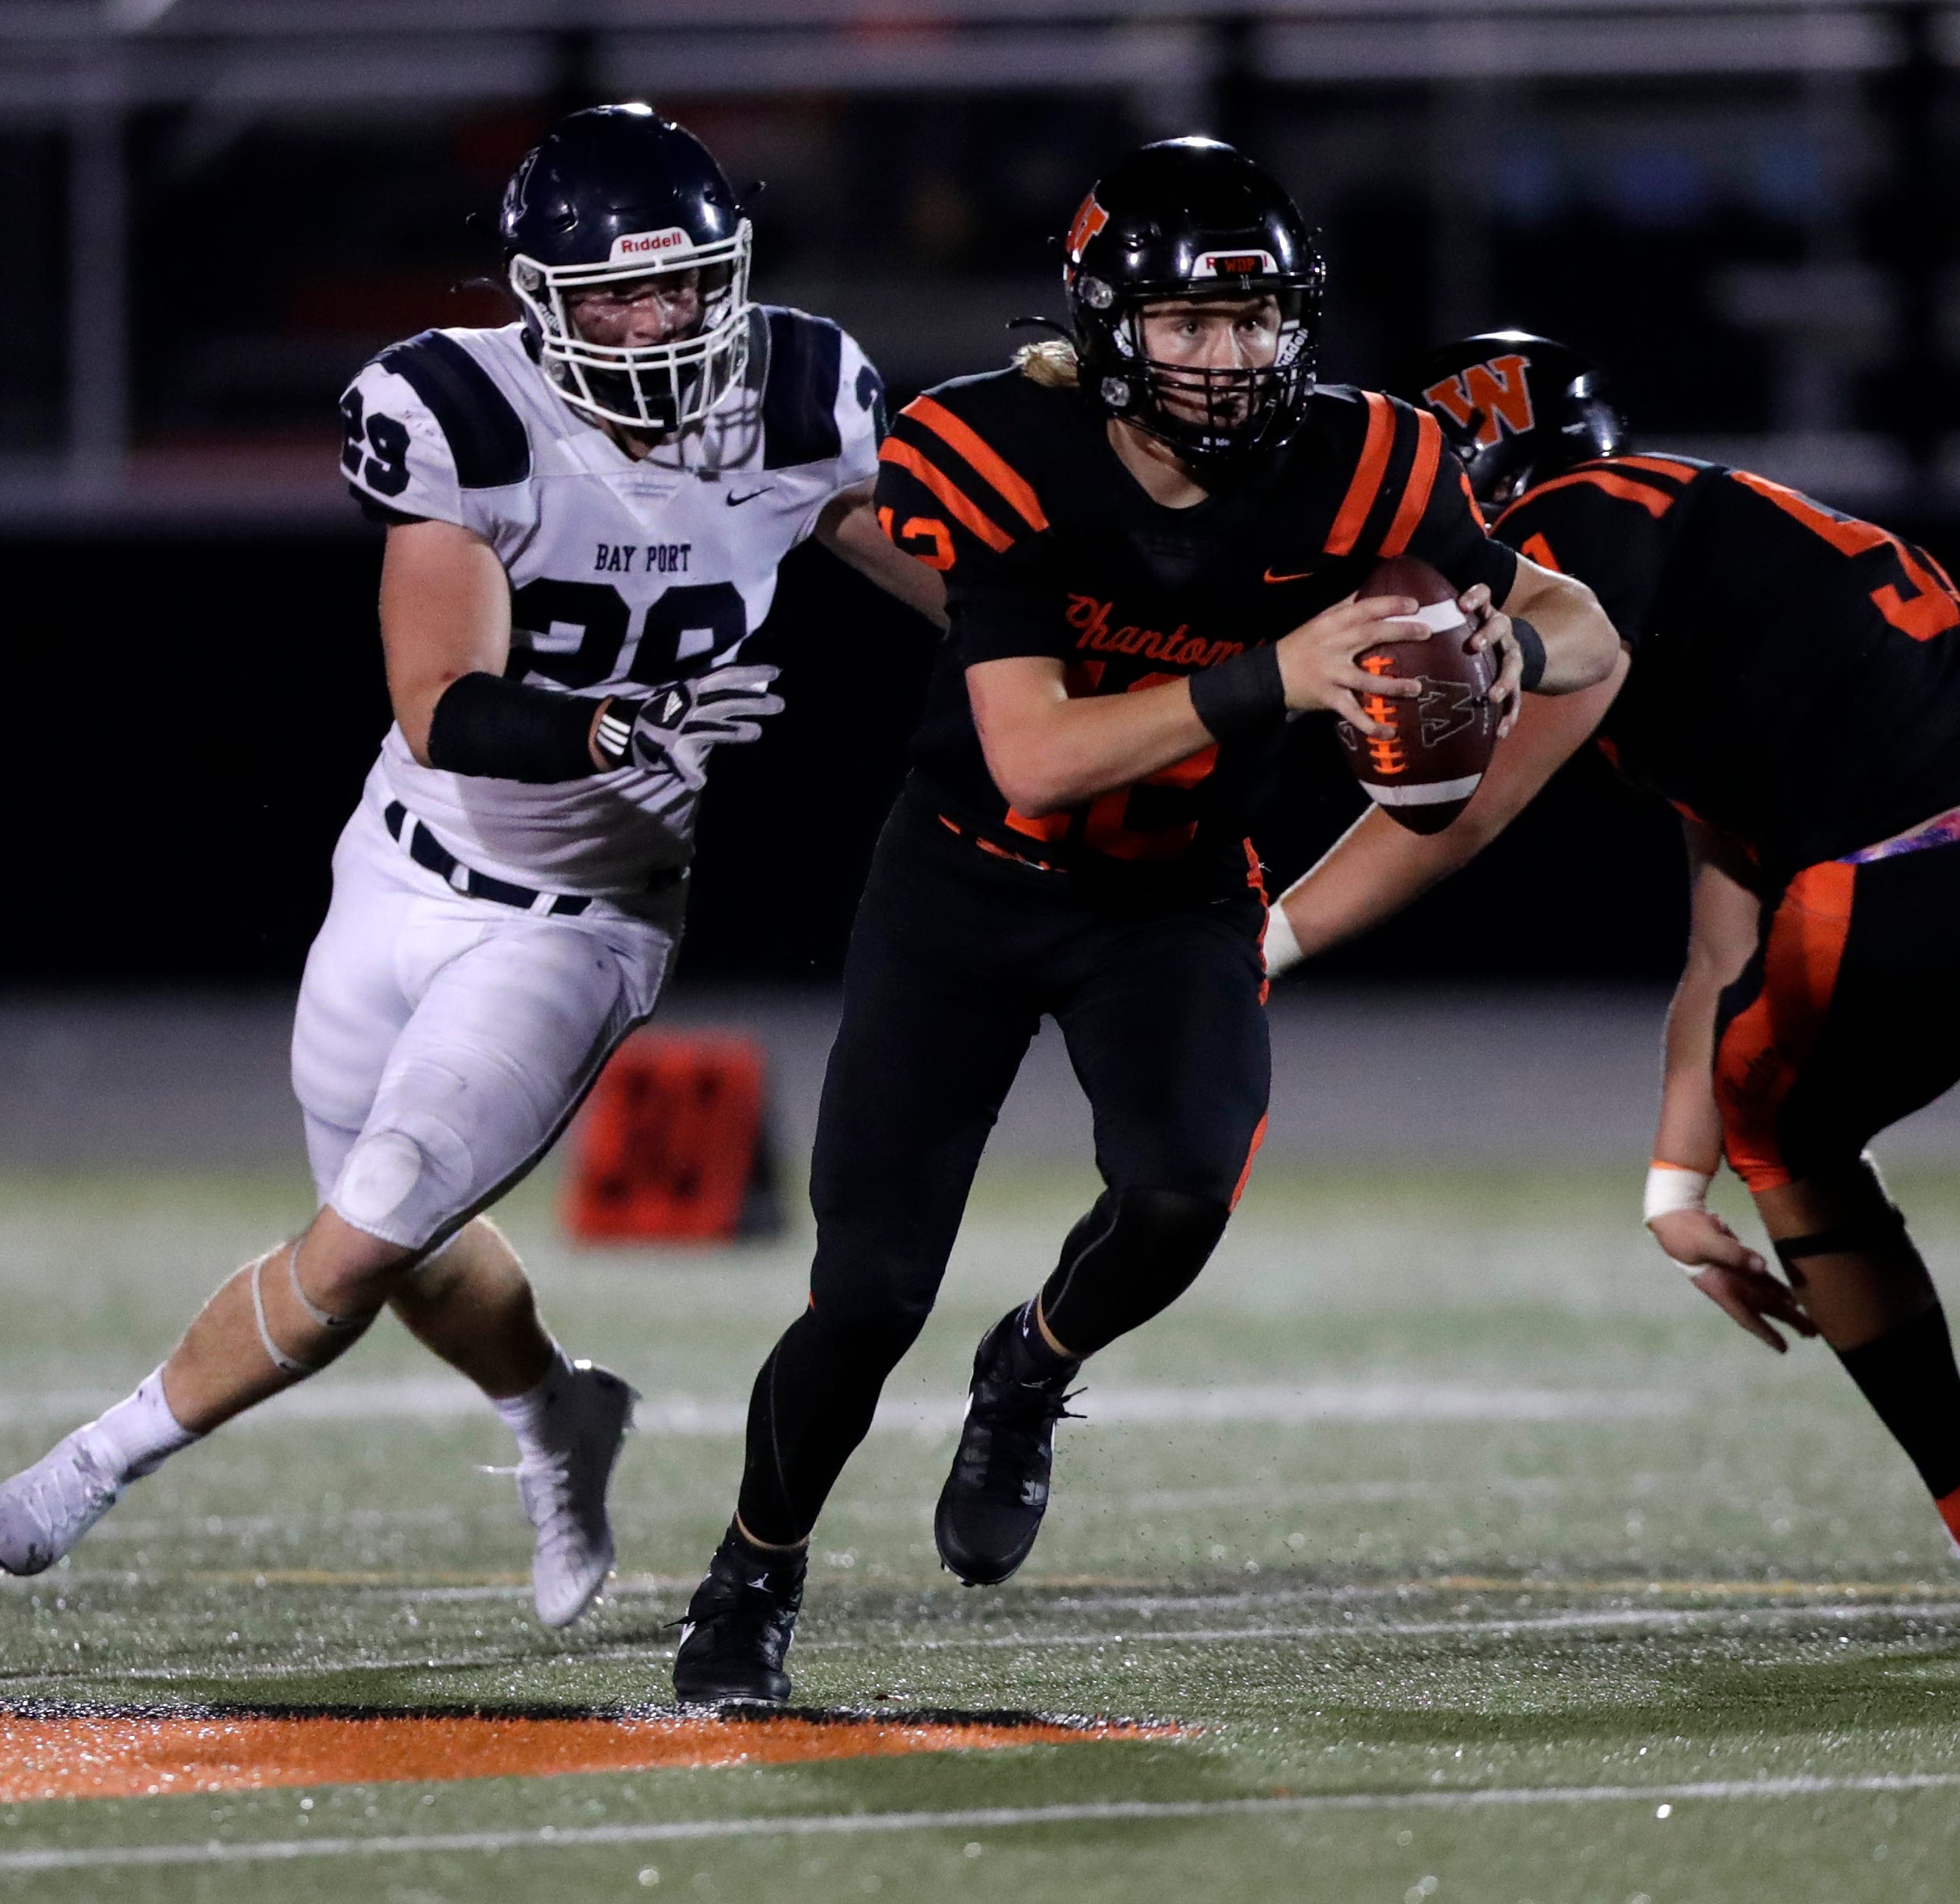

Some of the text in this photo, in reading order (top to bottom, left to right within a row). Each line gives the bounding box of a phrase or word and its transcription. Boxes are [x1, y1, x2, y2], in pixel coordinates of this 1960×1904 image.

[621, 232, 682, 253] Riddell
[1421, 353, 1536, 450] W
[340, 386, 411, 497] 29
[595, 544, 691, 572] BAY PORT
[1066, 592, 1268, 667] Phantom
